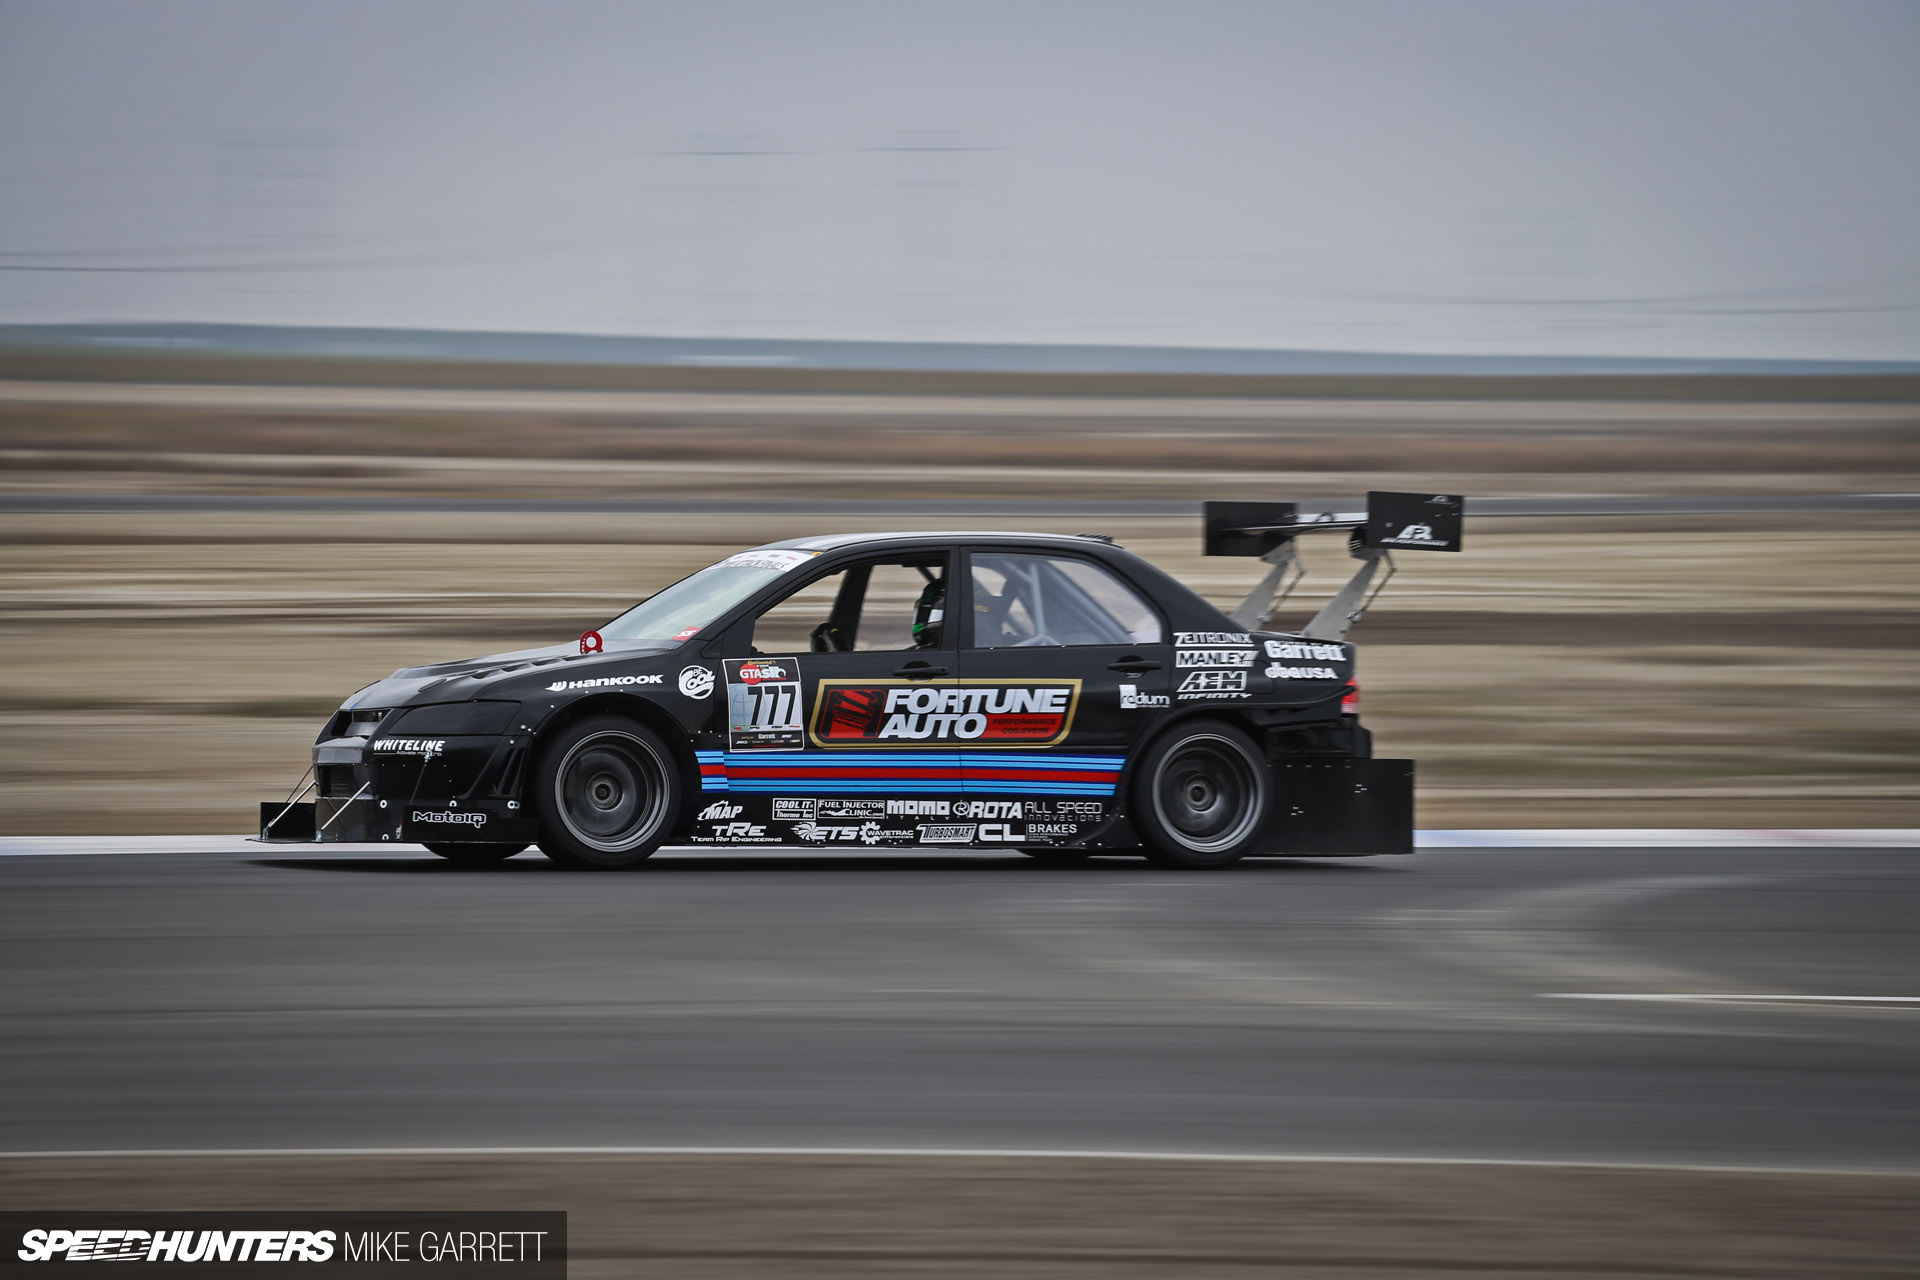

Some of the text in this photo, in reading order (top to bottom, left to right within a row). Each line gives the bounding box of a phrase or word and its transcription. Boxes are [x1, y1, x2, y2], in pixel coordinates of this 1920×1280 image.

[1173, 632, 1255, 647] ZEITRONIX
[1264, 640, 1347, 661] Garrett
[1177, 651, 1250, 667] MANLEY
[569, 675, 664, 689] HANKOOK
[1176, 671, 1248, 692] AEM
[747, 685, 796, 726] 777
[884, 688, 1071, 713] FORTUNE
[878, 713, 988, 739] AUTO
[373, 740, 446, 752] WHITELINE
[704, 805, 743, 820] MAP
[776, 801, 799, 809] COOL
[843, 801, 884, 809] INJECTOR
[886, 800, 951, 815] MOMO
[969, 802, 1023, 818] ROTA
[1025, 801, 1102, 814] ALL SPEED
[413, 811, 487, 828] MotoIQ
[776, 809, 814, 818] Thermo Tec
[1024, 814, 1102, 822] innovations
[712, 822, 767, 836] TRE
[809, 826, 860, 840] ETS
[917, 824, 977, 839] TURBOSMART
[979, 823, 1025, 841] CL
[1029, 824, 1078, 833] BRAKES
